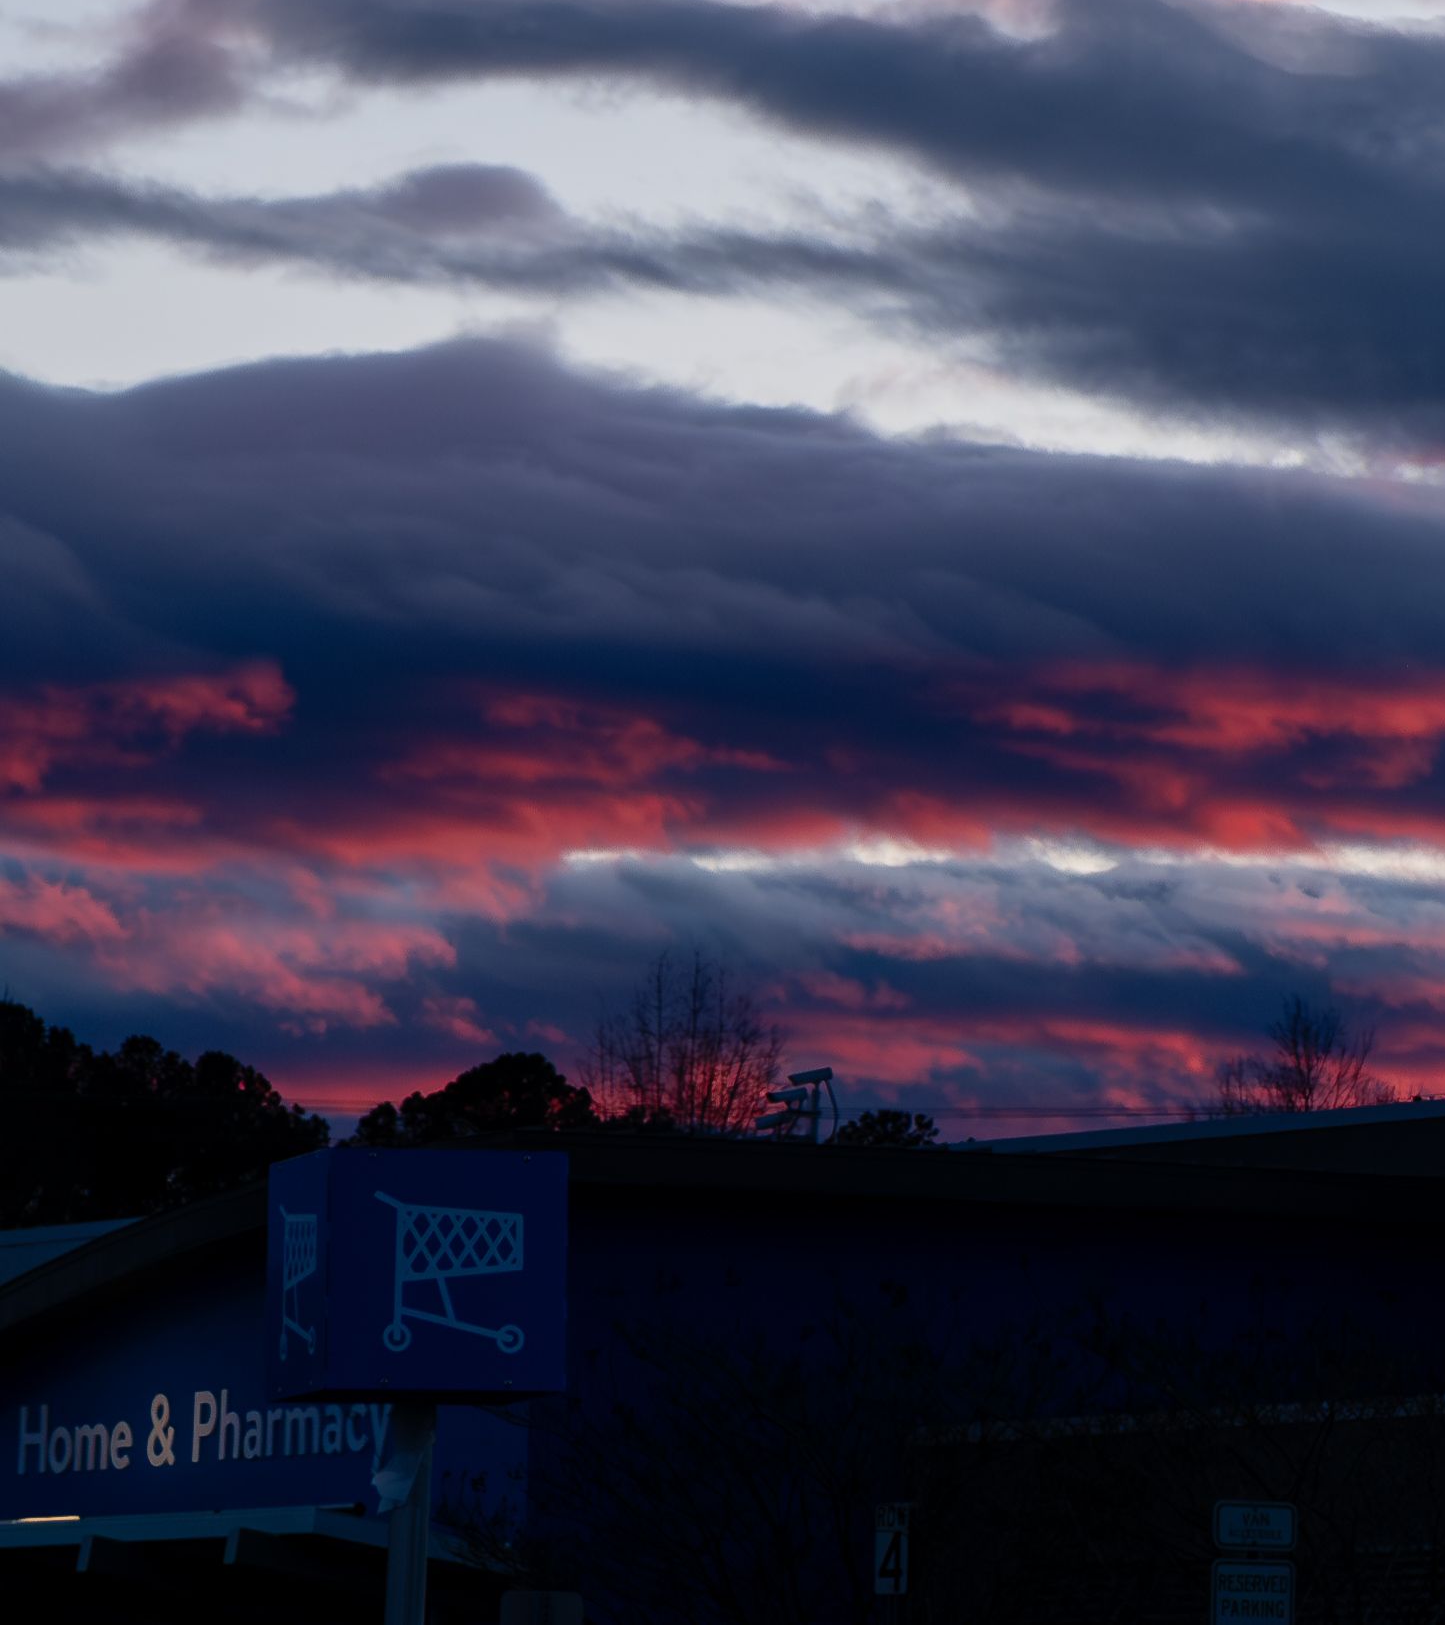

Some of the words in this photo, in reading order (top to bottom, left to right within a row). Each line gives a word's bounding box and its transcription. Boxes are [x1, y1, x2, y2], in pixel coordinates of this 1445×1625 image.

[17, 1404, 133, 1475] Home
[145, 1392, 174, 1467] &
[190, 1388, 393, 1473] Pharmacy
[1242, 1512, 1271, 1526] VAN
[879, 1531, 902, 1592] 4
[1218, 1574, 1289, 1593] RESERVED
[1221, 1599, 1285, 1618] PARKING
